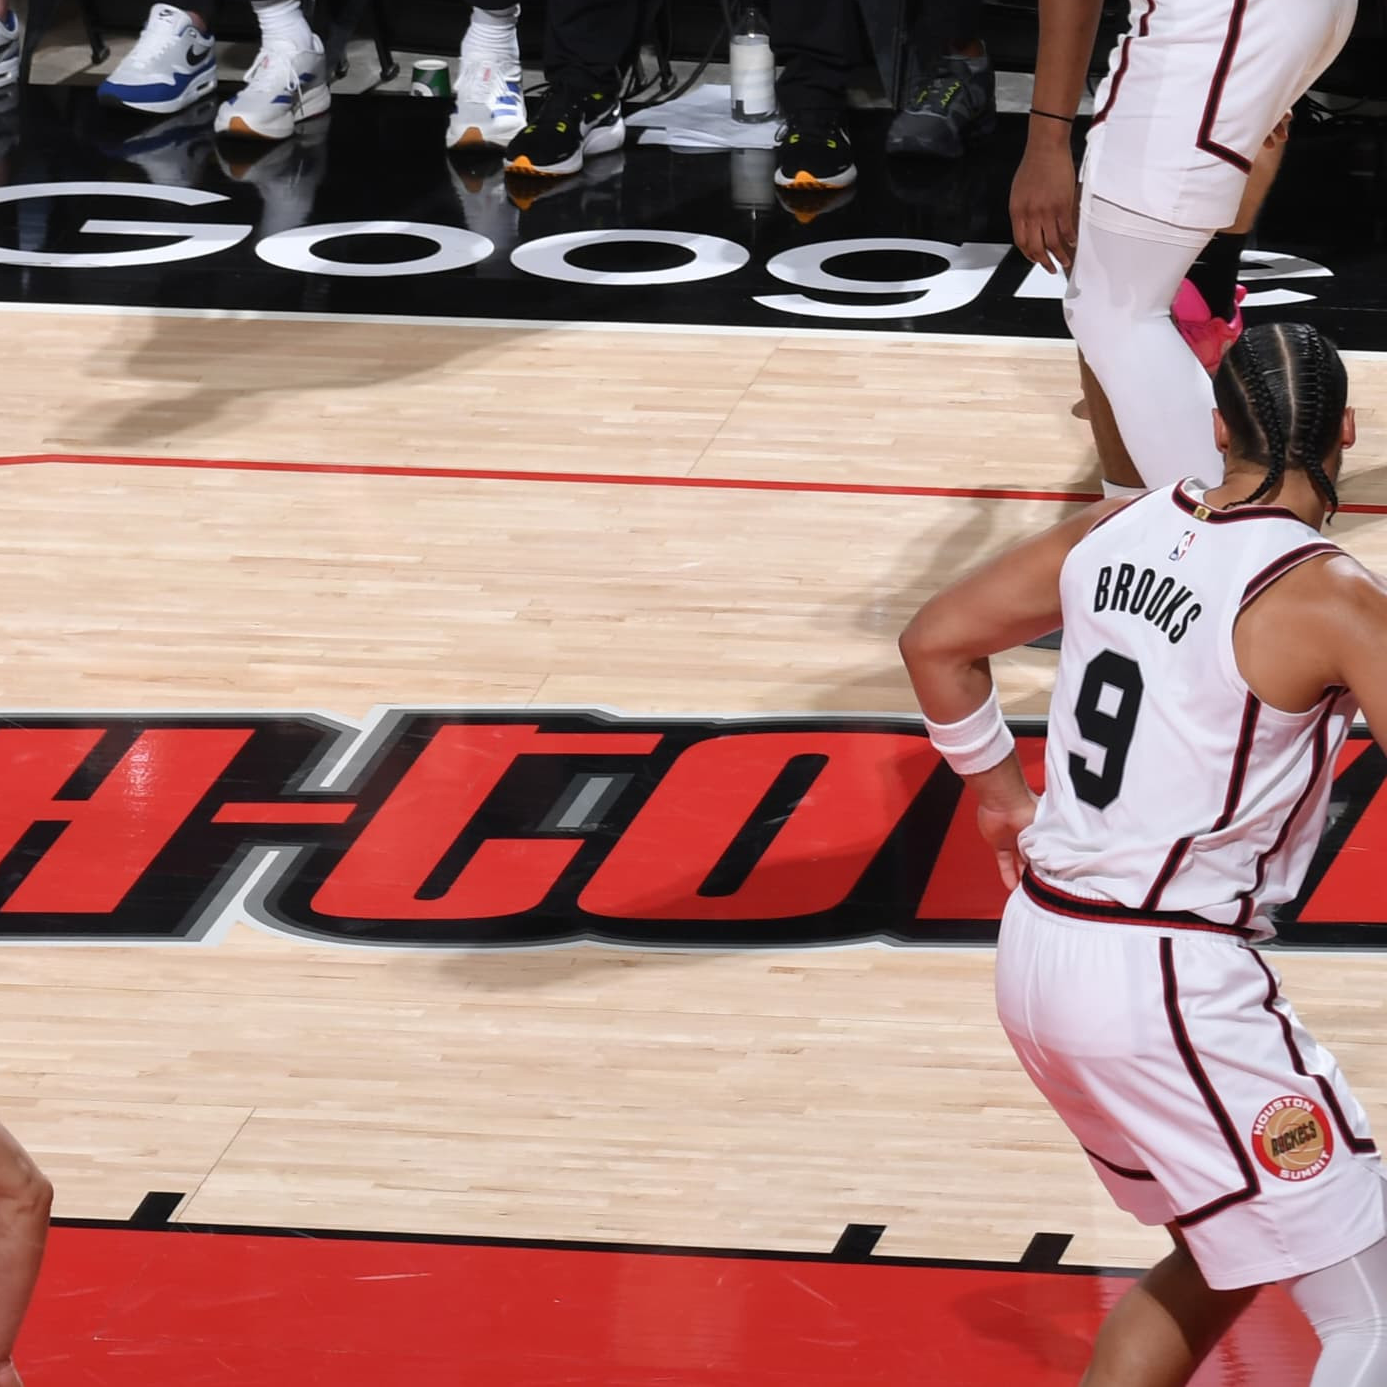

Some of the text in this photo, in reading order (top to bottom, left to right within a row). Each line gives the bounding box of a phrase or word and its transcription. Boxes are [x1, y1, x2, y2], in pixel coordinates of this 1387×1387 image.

[1094, 562, 1203, 645] BROOKS
[1068, 648, 1144, 811] 9
[1253, 1097, 1315, 1136] HOUSTON
[1279, 1149, 1331, 1181] SUMMIT
